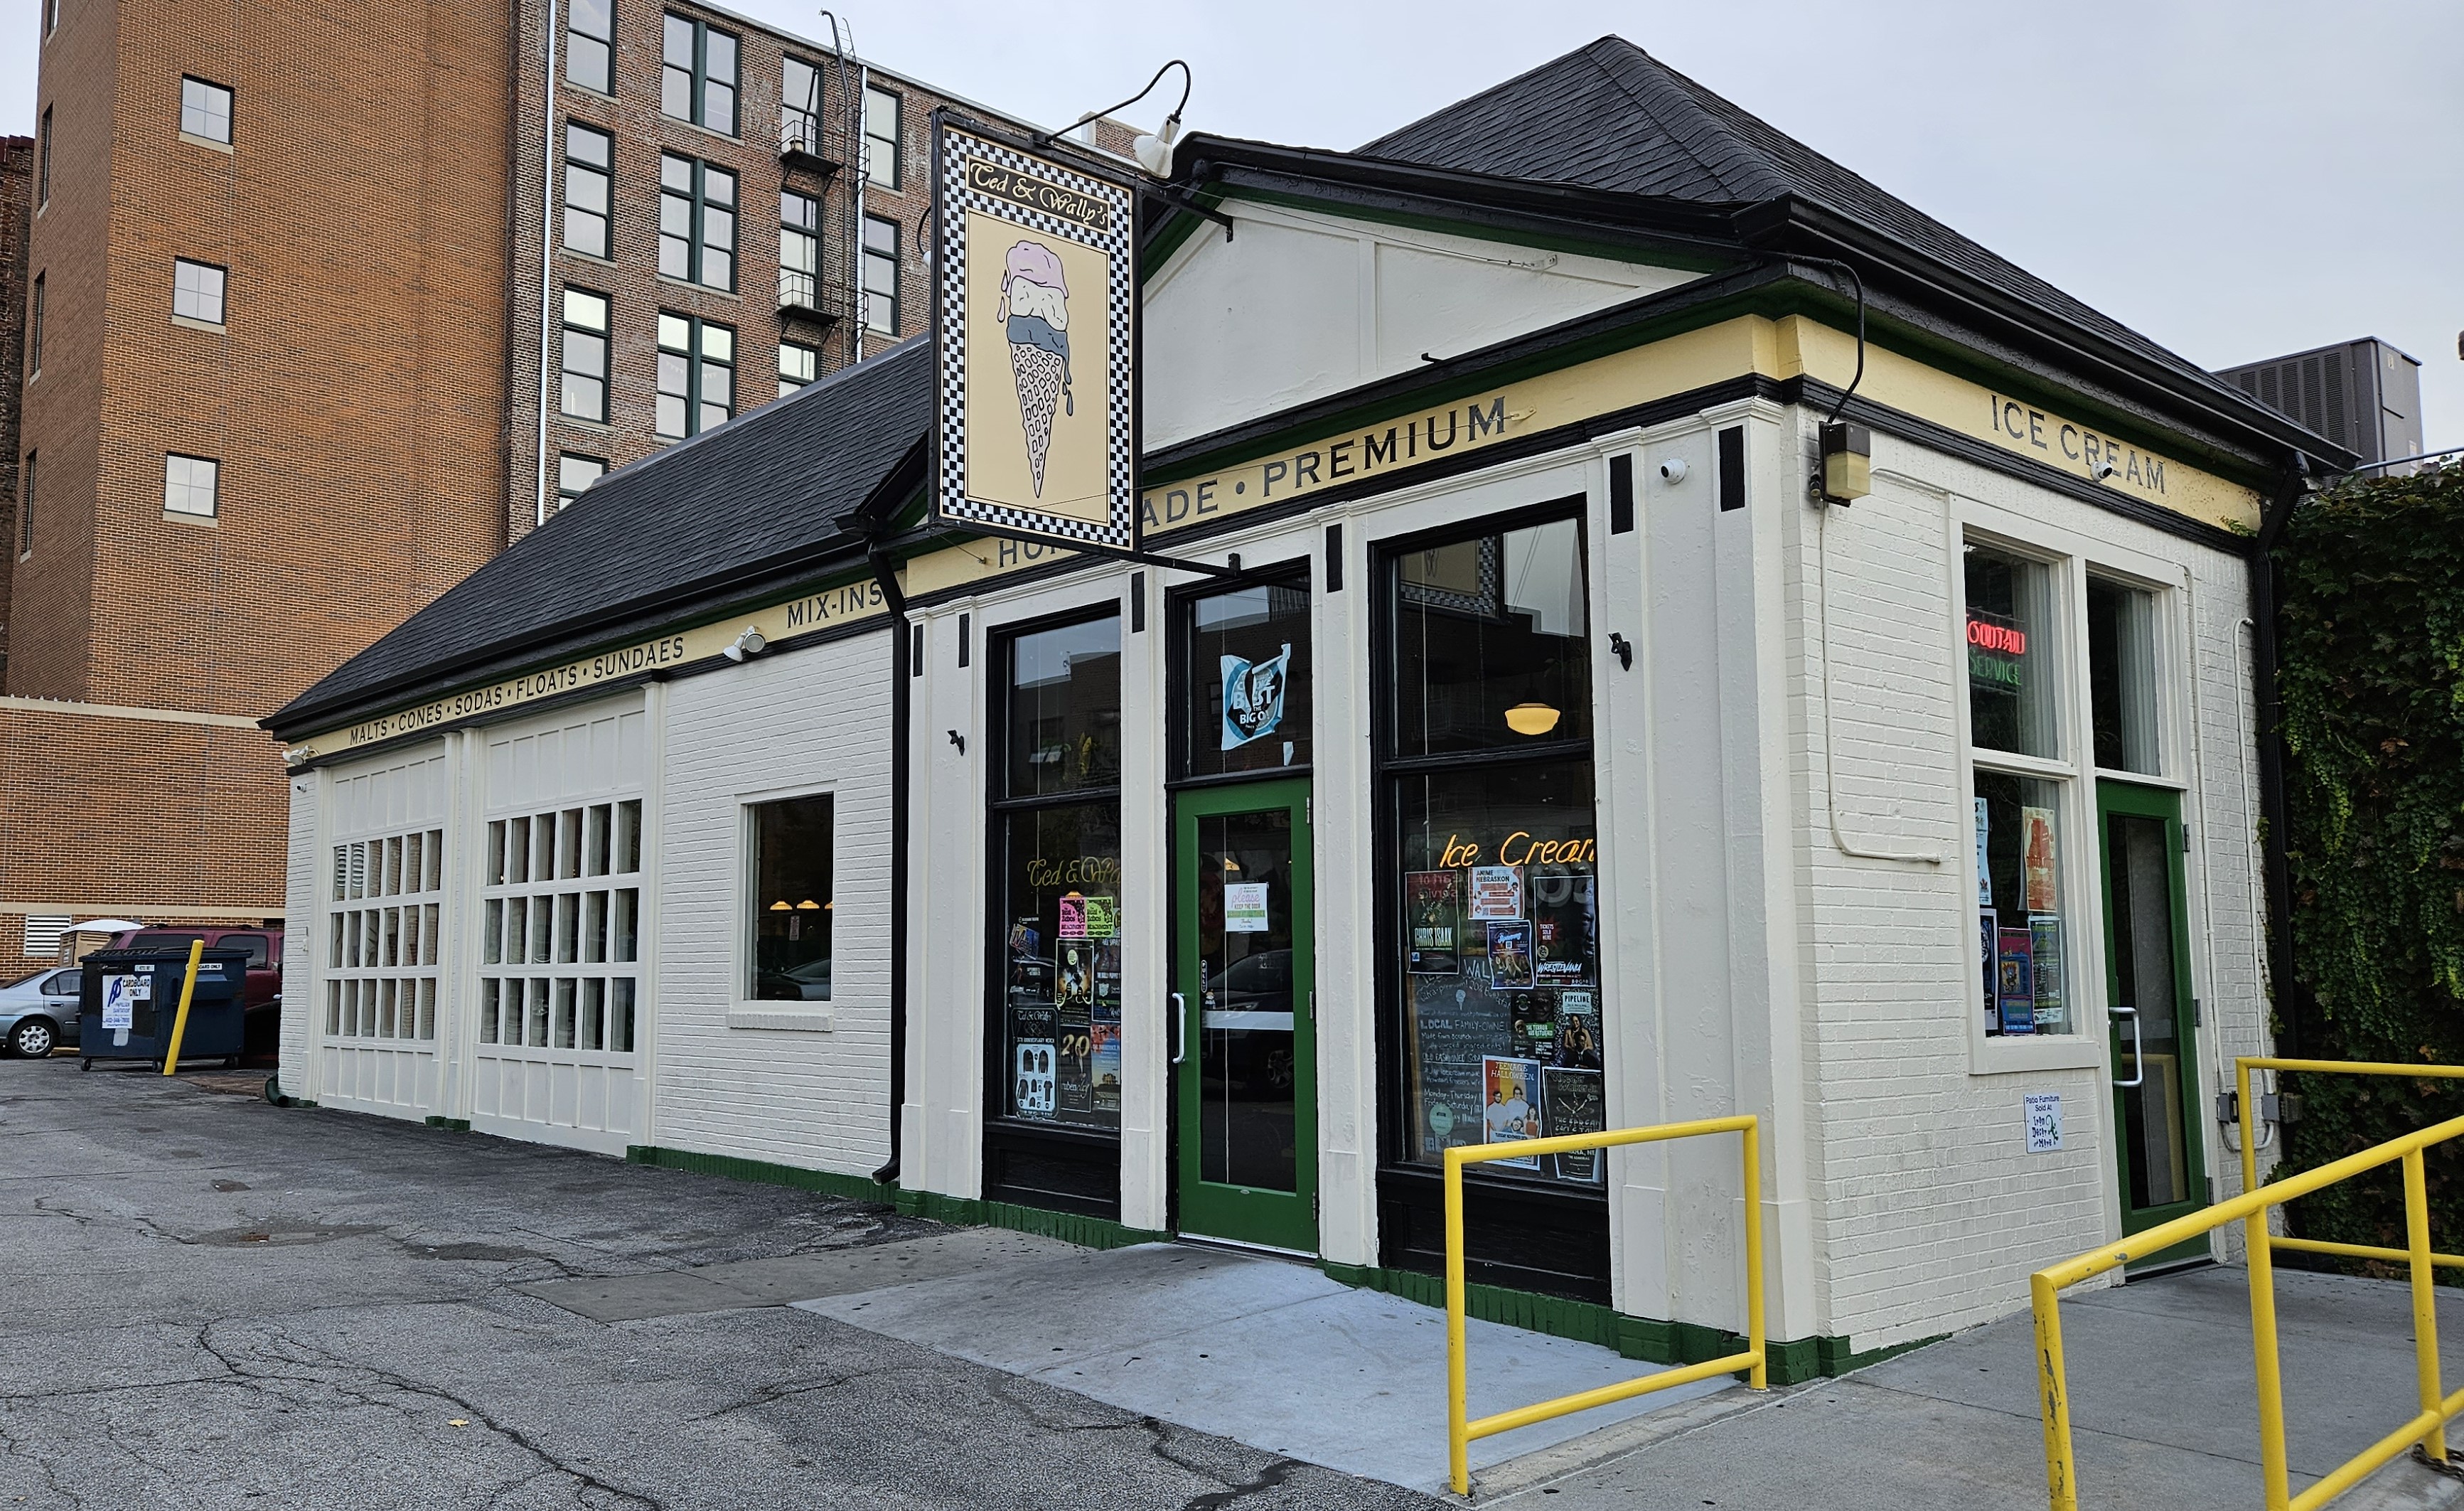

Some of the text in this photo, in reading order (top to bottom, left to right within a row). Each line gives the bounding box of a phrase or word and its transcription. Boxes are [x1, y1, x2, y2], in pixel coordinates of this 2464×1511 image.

[970, 162, 1108, 225] Ted & Wally's
[1263, 396, 1506, 498] PREMIUM
[1991, 394, 2165, 494] ICE CREAM
[350, 720, 387, 747] MALTS
[398, 703, 442, 731] CONES
[455, 687, 502, 716] SODAS
[516, 665, 577, 700] FLOATS
[594, 636, 684, 678] SUNDAES
[1240, 712, 1257, 725] BIG
[1440, 833, 1479, 868] Ice
[1027, 858, 1064, 887] Ted
[1066, 860, 1081, 883] &
[1231, 887, 1260, 909] please
[1414, 927, 1452, 947] CHRIS ISAAK
[122, 978, 150, 988] CARDBOARD
[129, 988, 142, 997] ONLY
[1420, 1018, 1453, 1030] LOCAL
[1491, 1069, 1535, 1081] HALLOWEEN
[1495, 1061, 1528, 1072] TEENAGE
